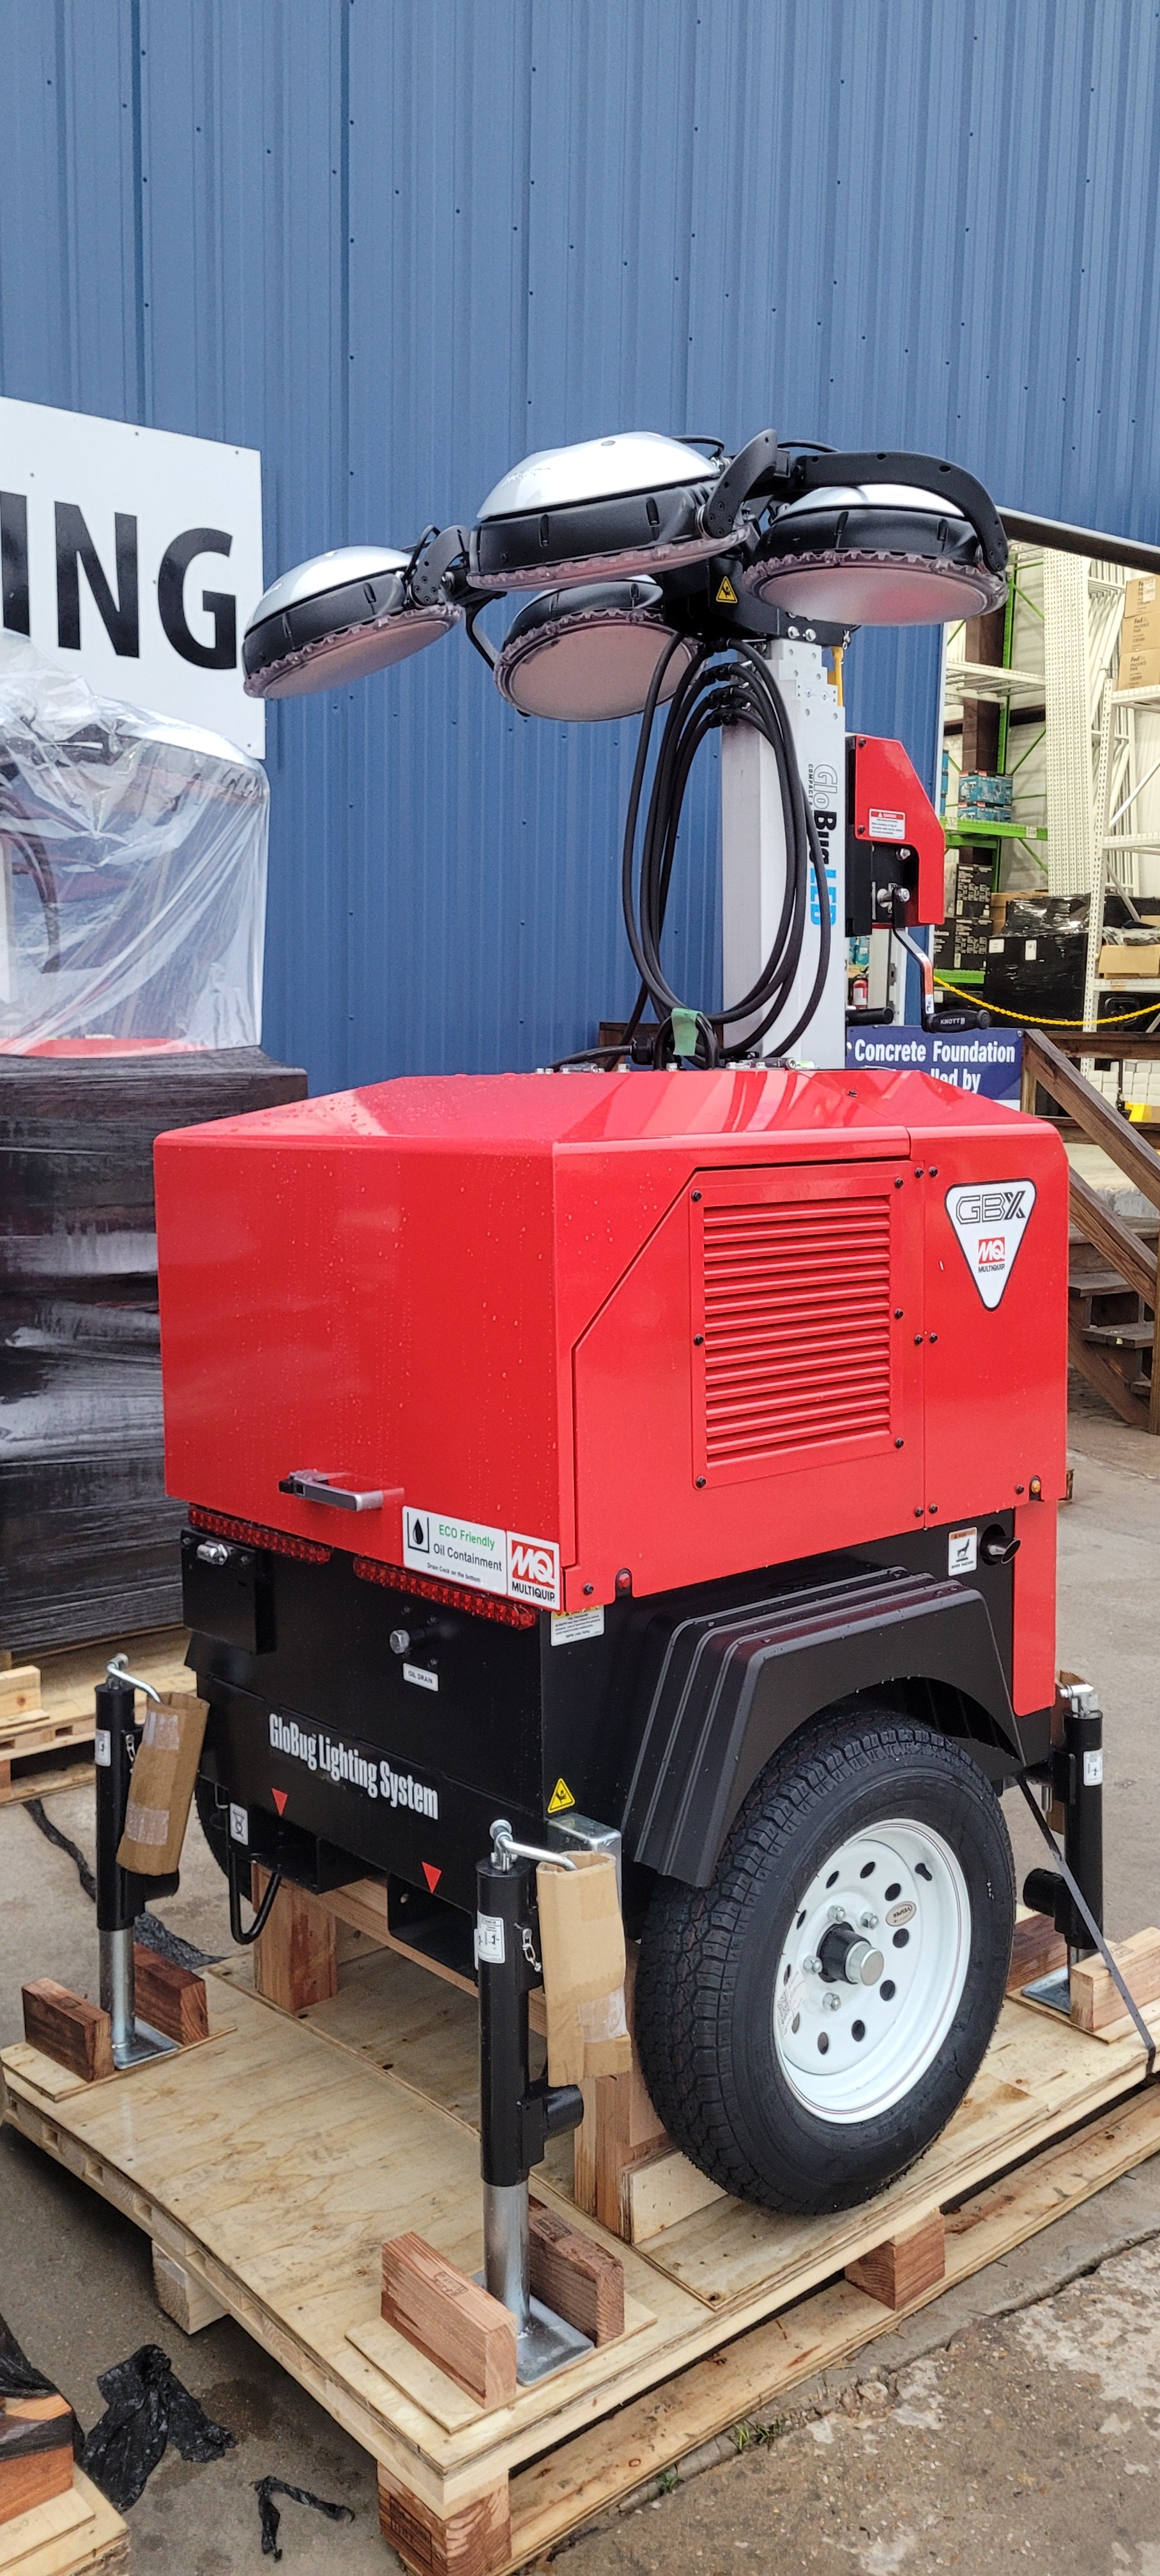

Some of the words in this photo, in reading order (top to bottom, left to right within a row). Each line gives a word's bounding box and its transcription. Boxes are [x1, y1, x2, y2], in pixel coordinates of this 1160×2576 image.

[855, 1039, 926, 1062] Concrete
[933, 1040, 1015, 1062] Foundation
[963, 1068, 981, 1094] by
[956, 1190, 1026, 1225] GBX
[979, 1239, 1005, 1261] MQ
[978, 1263, 1005, 1273] MULTIQUIP
[439, 1524, 457, 1538] ECO
[460, 1530, 495, 1551] Friendly
[434, 1543, 445, 1556] Oil
[447, 1547, 502, 1572] Containment
[512, 1545, 554, 1584] MQ
[439, 1565, 450, 1574] Cock
[465, 1573, 480, 1583] bottom
[512, 1581, 555, 1602] MULTIQUIP
[417, 1673, 433, 1684] DRAIN
[269, 1713, 317, 1771] GloBug
[319, 1733, 378, 1798] Lighting
[379, 1760, 439, 1820] System
